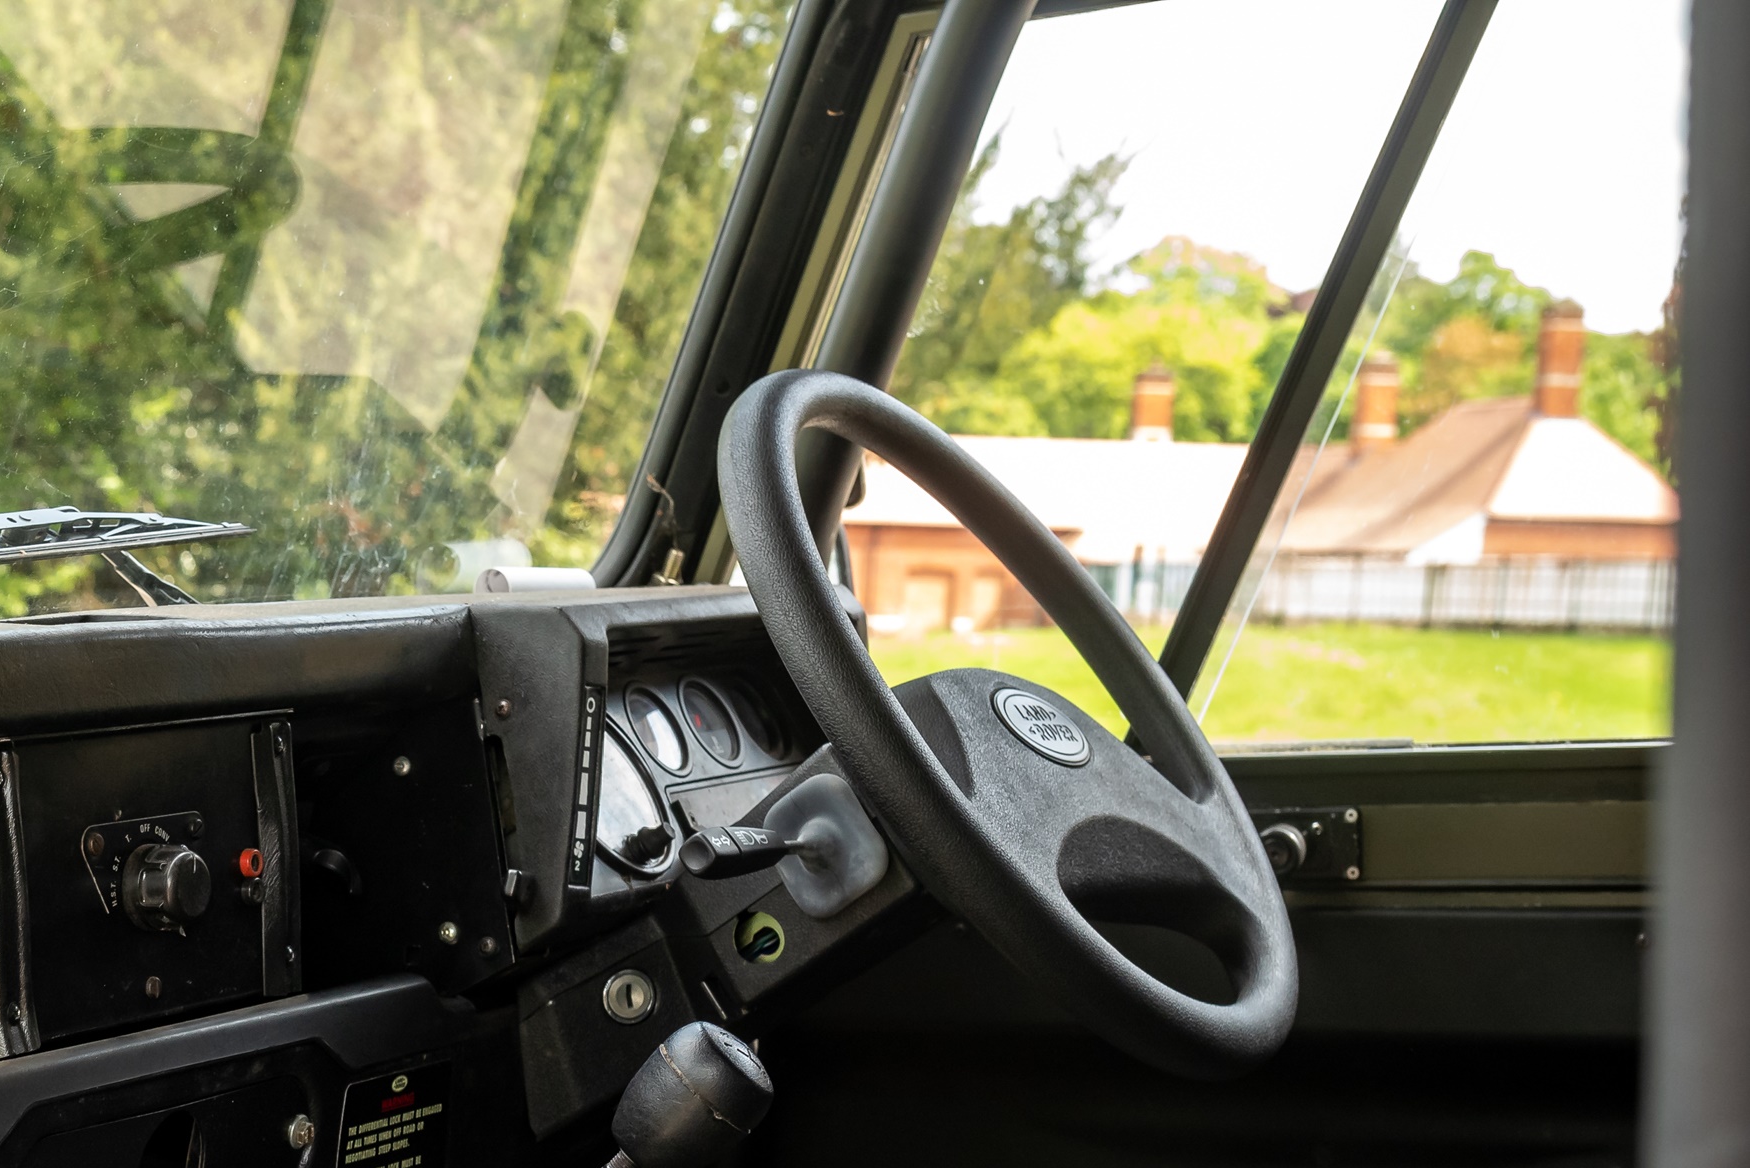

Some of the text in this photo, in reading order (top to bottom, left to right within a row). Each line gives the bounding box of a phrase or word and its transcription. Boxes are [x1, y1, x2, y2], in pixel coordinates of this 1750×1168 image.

[1014, 704, 1054, 721] LAND
[1032, 723, 1079, 742] ROVER
[139, 823, 151, 833] OFF
[574, 860, 581, 871] 2
